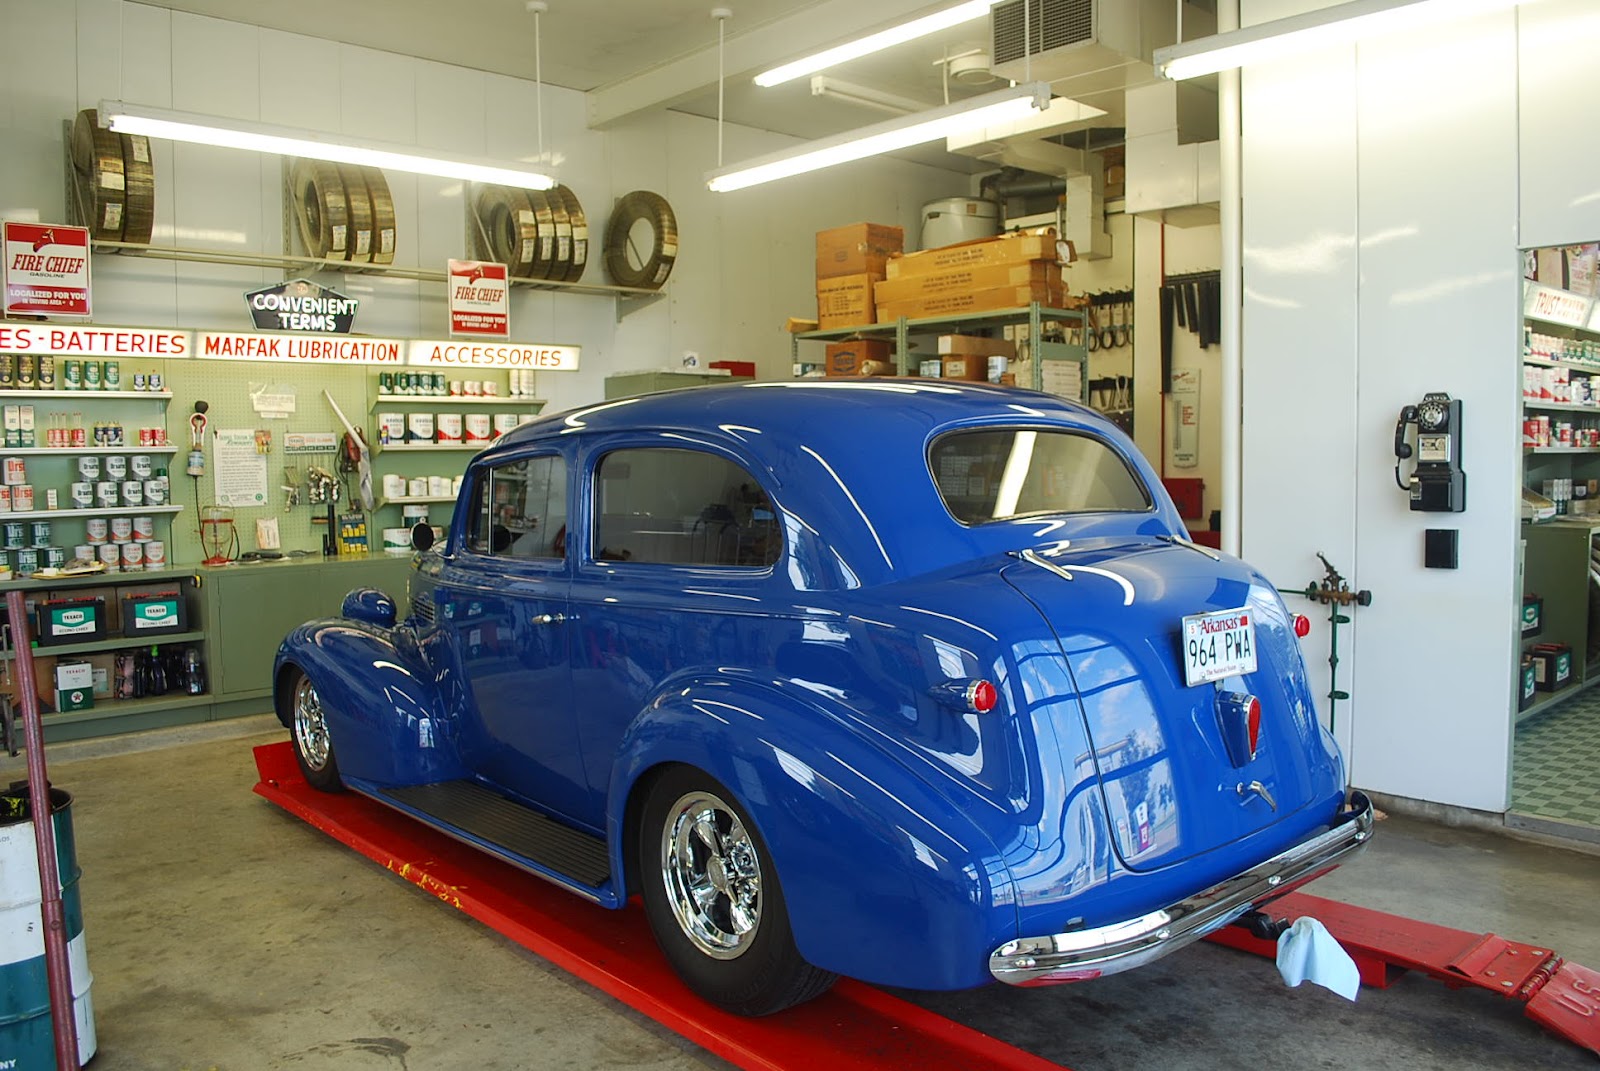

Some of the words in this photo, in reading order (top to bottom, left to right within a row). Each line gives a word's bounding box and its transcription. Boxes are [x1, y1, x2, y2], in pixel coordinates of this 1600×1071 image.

[12, 253, 43, 272] FIRE
[45, 255, 84, 274] CHIEF
[29, 271, 65, 279] GASOLINE
[10, 289, 52, 299] LOCALIZED
[53, 291, 69, 299] FOR
[70, 292, 86, 300] YOU
[253, 293, 359, 315] CONVENIENT
[455, 286, 477, 300] FIRE
[478, 288, 504, 302] CHIEF
[278, 312, 337, 331] TERMS
[51, 331, 185, 354] BATTERIES
[205, 336, 281, 358] MARFAK
[288, 339, 399, 362] LUBRICATION
[430, 345, 562, 367] ACCESSORIES
[1201, 617, 1238, 635] Arkansas
[1189, 635, 1217, 668] 964
[1225, 629, 1251, 662] PWA
